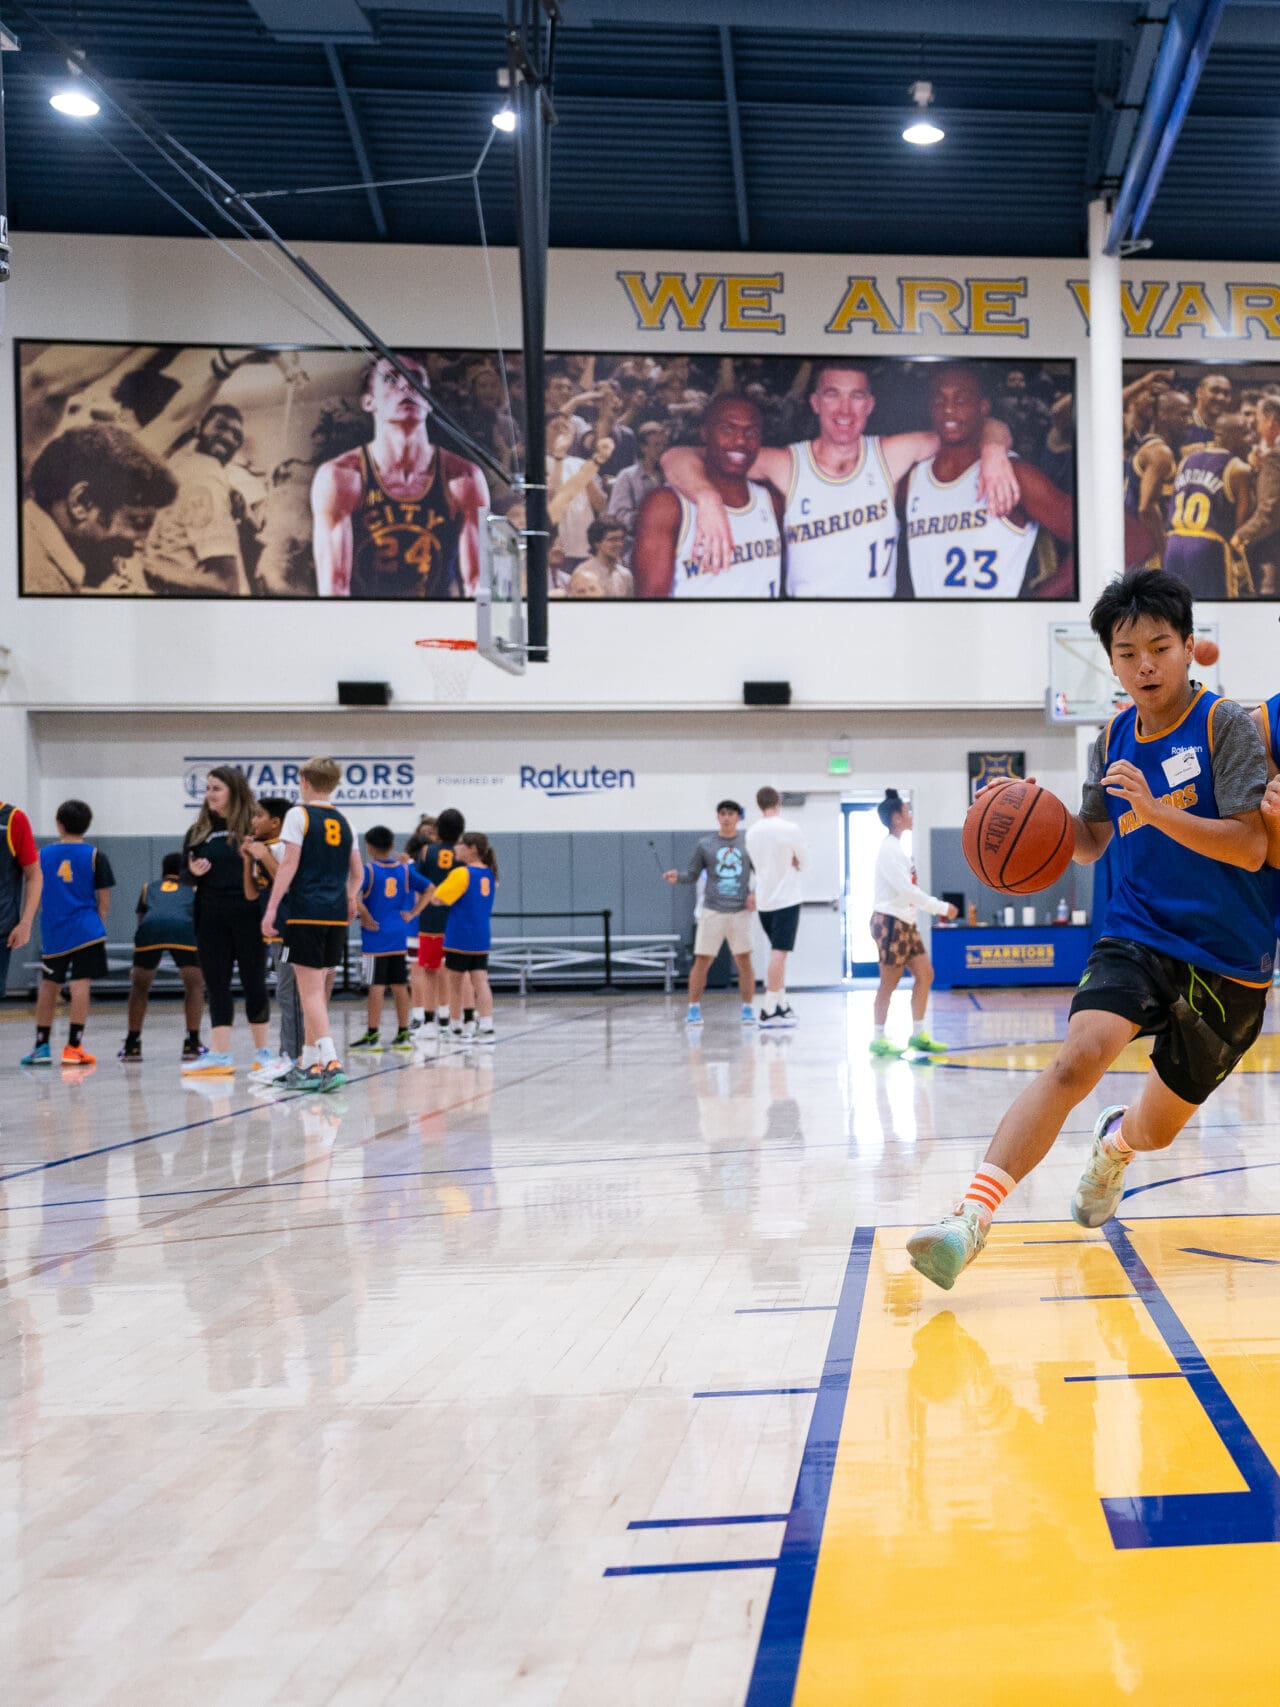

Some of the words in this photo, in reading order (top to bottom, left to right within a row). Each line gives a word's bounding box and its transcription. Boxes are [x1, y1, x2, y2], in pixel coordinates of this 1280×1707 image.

[617, 272, 785, 335] WE
[824, 277, 1030, 338] ARE
[364, 503, 445, 531] CITY
[785, 499, 889, 544] WARRIORS
[1171, 492, 1211, 531] 10
[868, 537, 897, 579] 17
[943, 546, 1000, 590] 23
[519, 764, 635, 789] Rakuten
[336, 788, 414, 800] ACADEMY
[324, 818, 342, 847] 8
[983, 810, 1016, 855] ROCK
[57, 859, 74, 882] 4
[437, 849, 454, 869] 8
